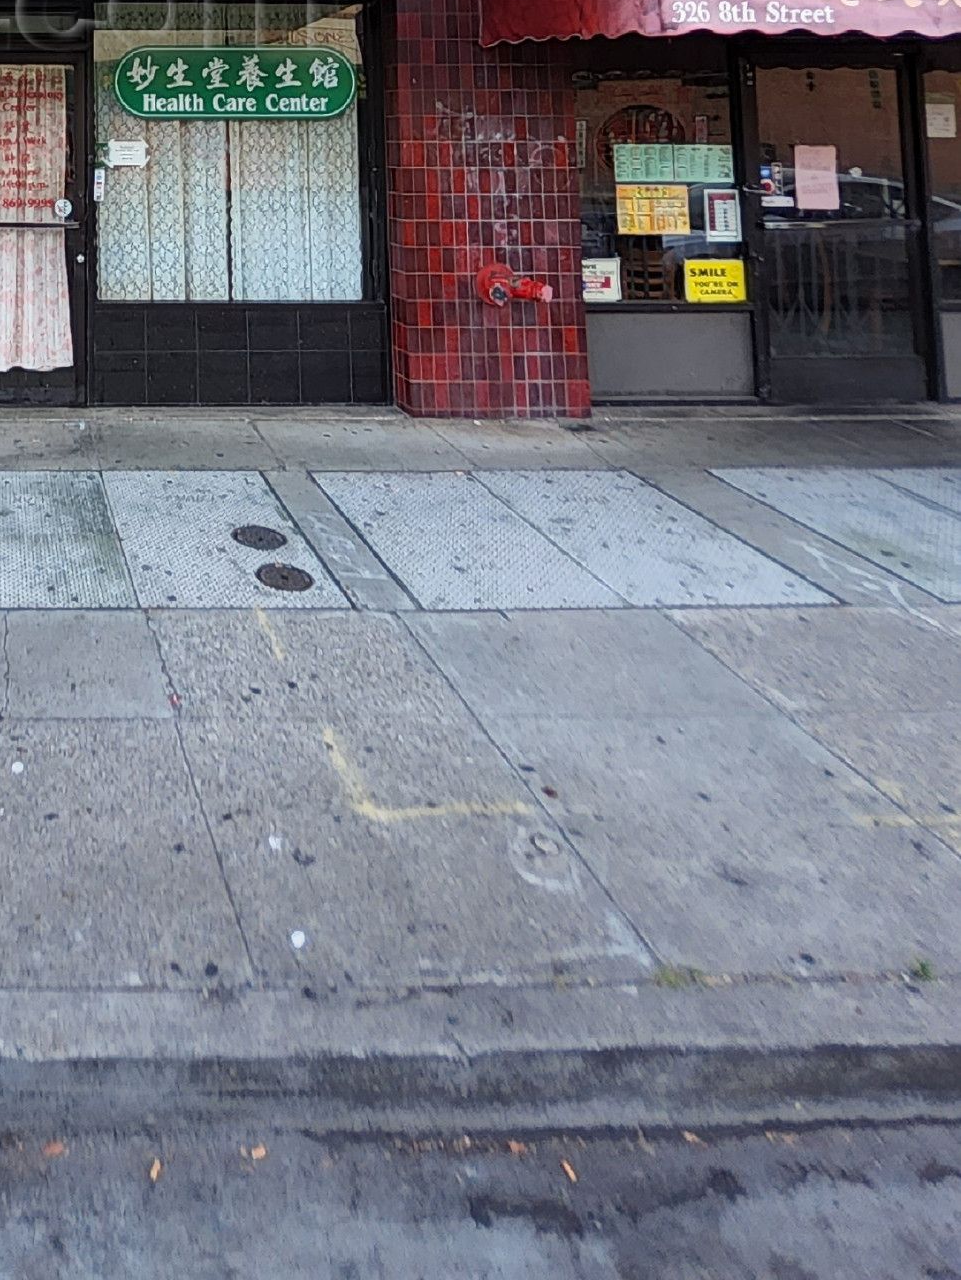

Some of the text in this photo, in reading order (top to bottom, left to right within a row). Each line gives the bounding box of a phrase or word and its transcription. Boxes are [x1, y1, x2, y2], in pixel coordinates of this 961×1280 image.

[672, 0, 836, 24] 326 8th Street
[126, 53, 340, 91] 妙生堂養生館
[143, 93, 328, 112] Health Care Center
[689, 267, 728, 278] SMILE
[699, 288, 734, 296] CAMERA
